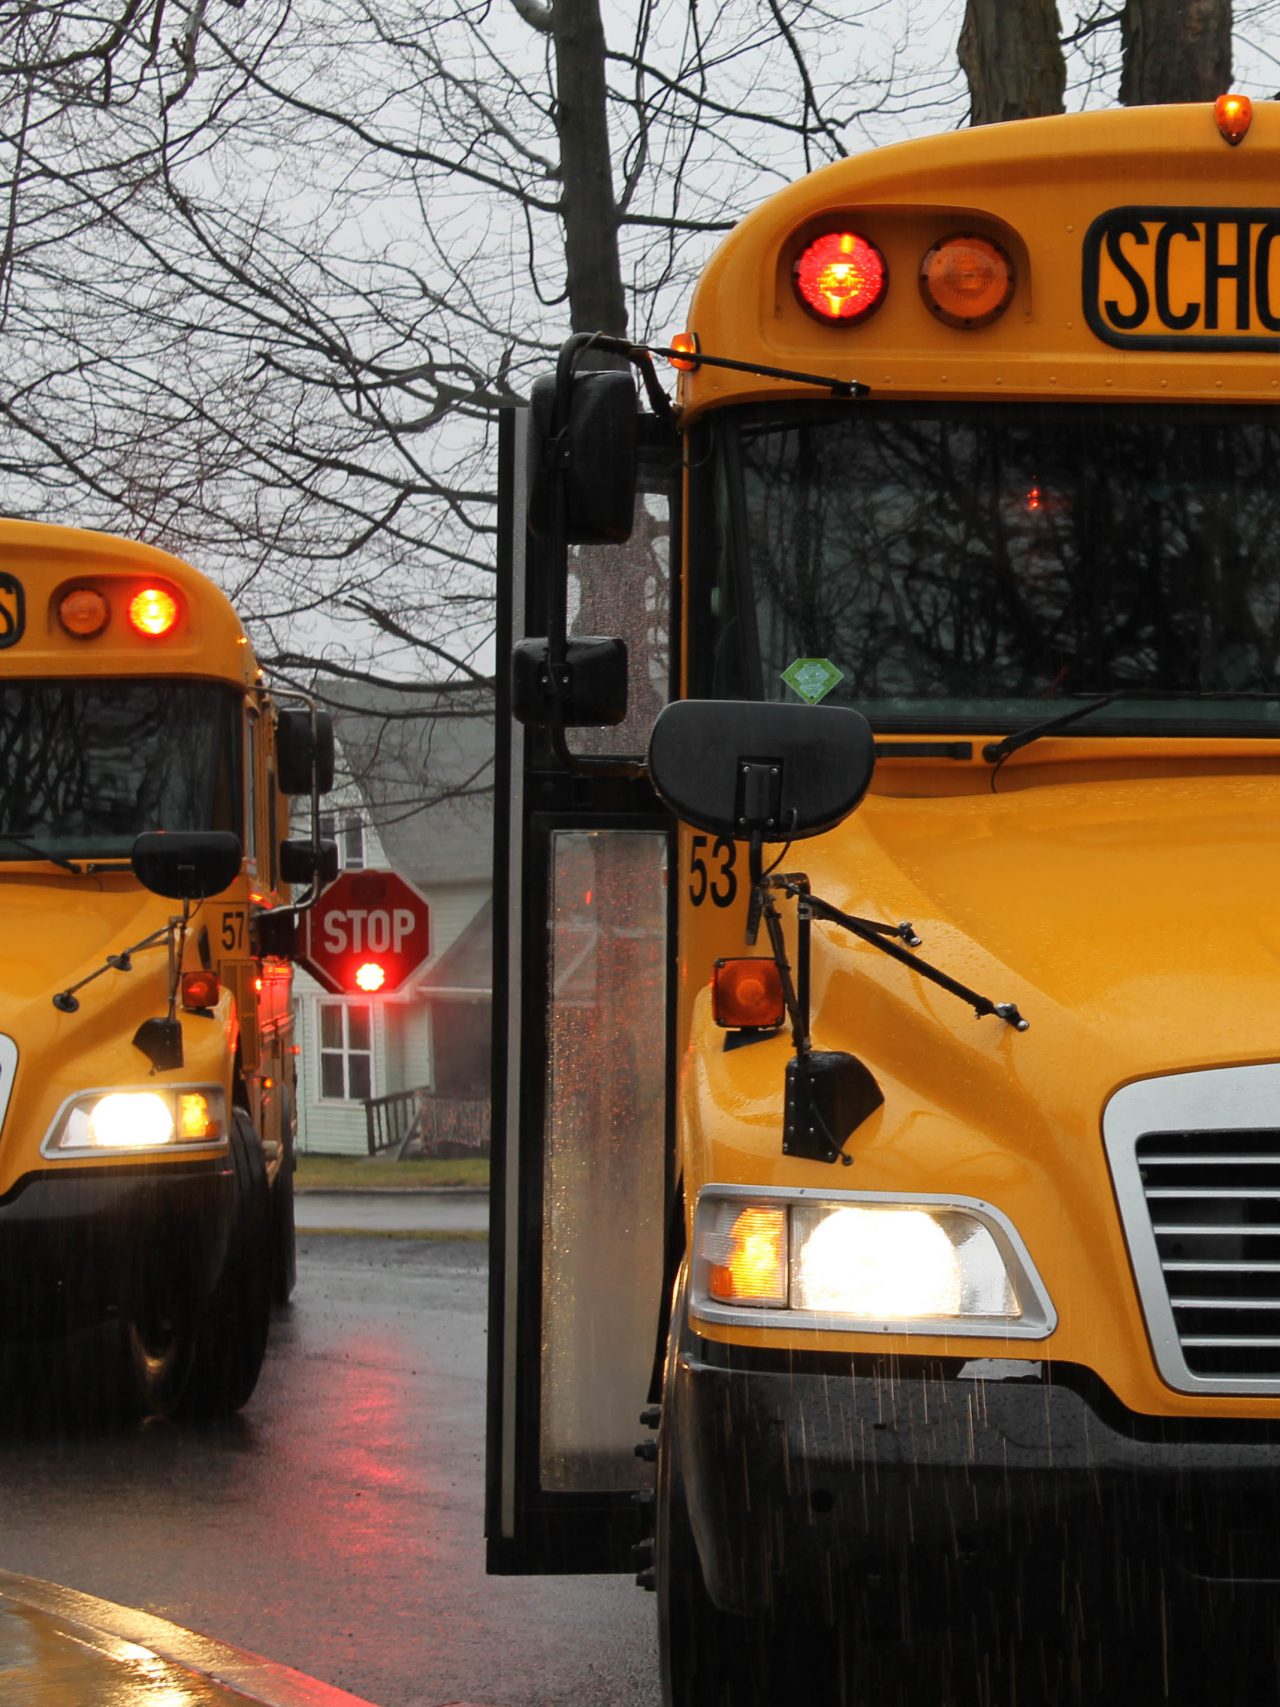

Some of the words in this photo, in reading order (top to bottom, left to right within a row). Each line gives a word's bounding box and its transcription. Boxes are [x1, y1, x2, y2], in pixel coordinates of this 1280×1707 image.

[689, 835, 737, 908] 53
[221, 911, 245, 951] 57
[323, 909, 415, 954] STOP
